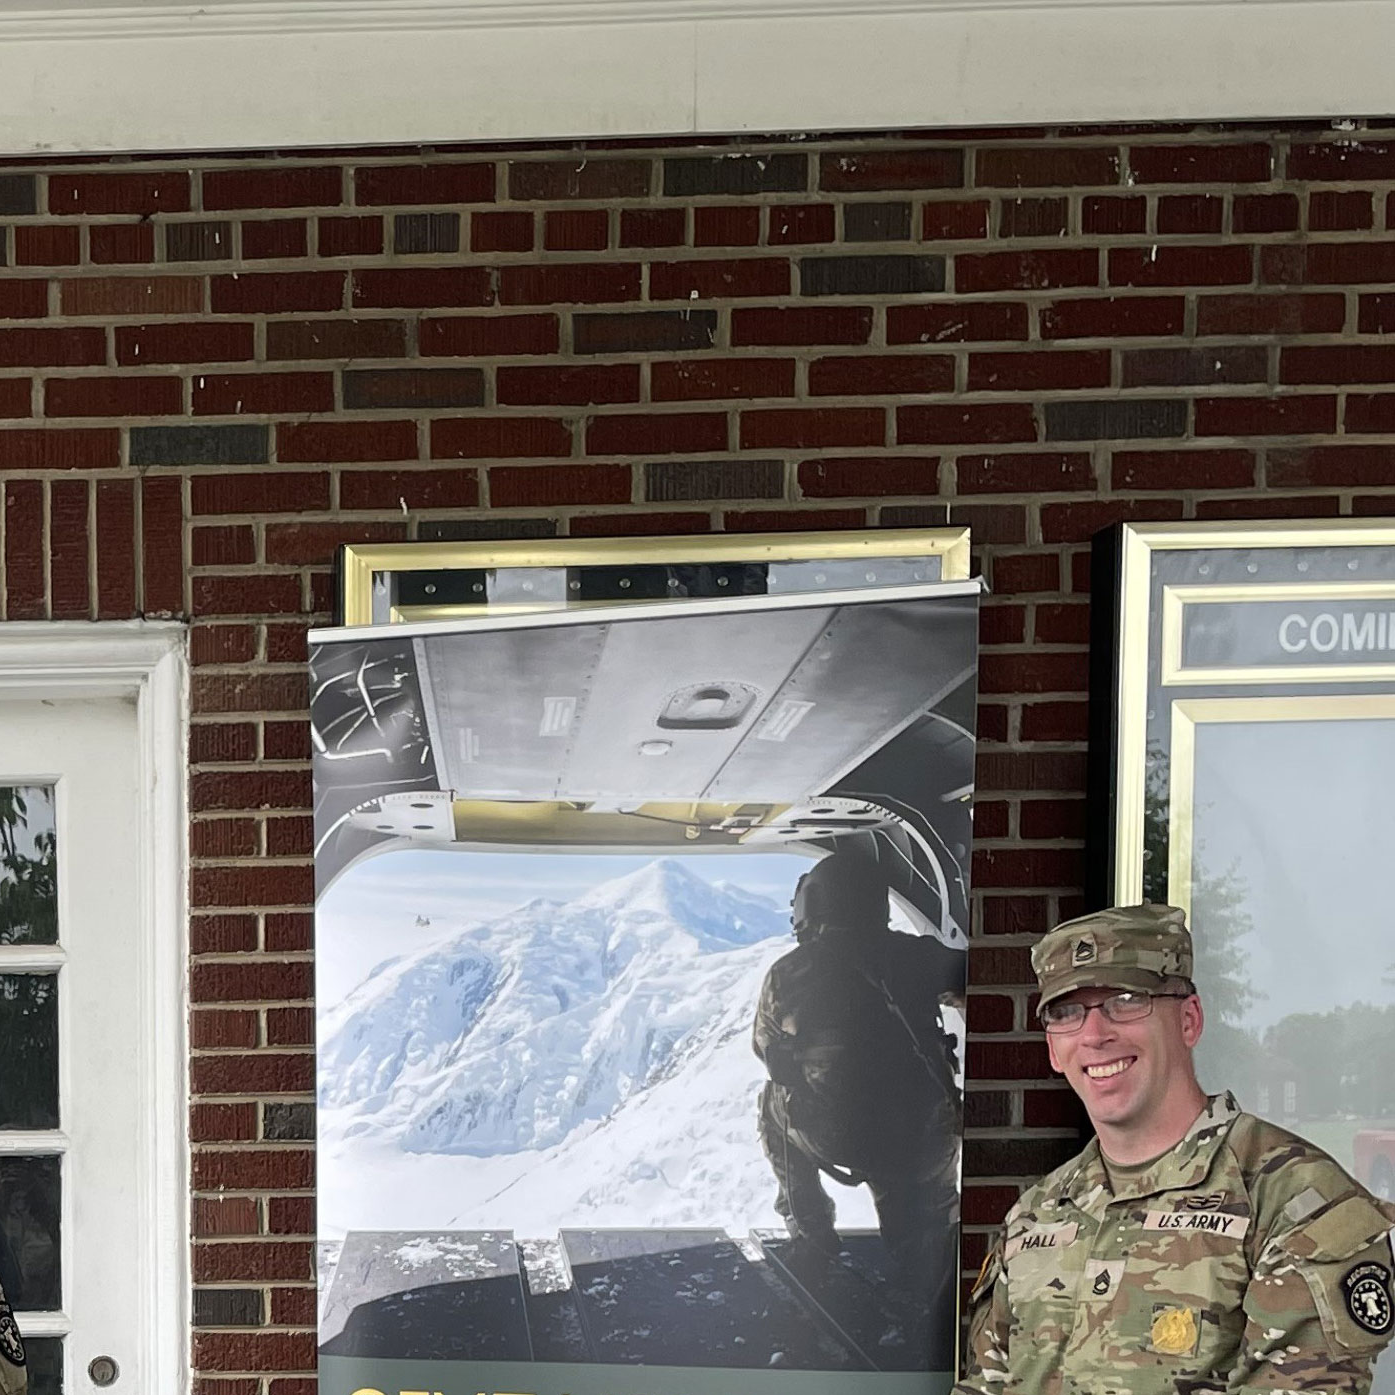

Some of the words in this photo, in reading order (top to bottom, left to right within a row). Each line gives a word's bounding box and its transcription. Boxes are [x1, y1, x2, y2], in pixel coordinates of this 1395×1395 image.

[1278, 611, 1395, 653] COMI
[1158, 1214, 1182, 1229] U.S.
[1187, 1214, 1234, 1233] ARMY
[1020, 1234, 1056, 1250] HALL
